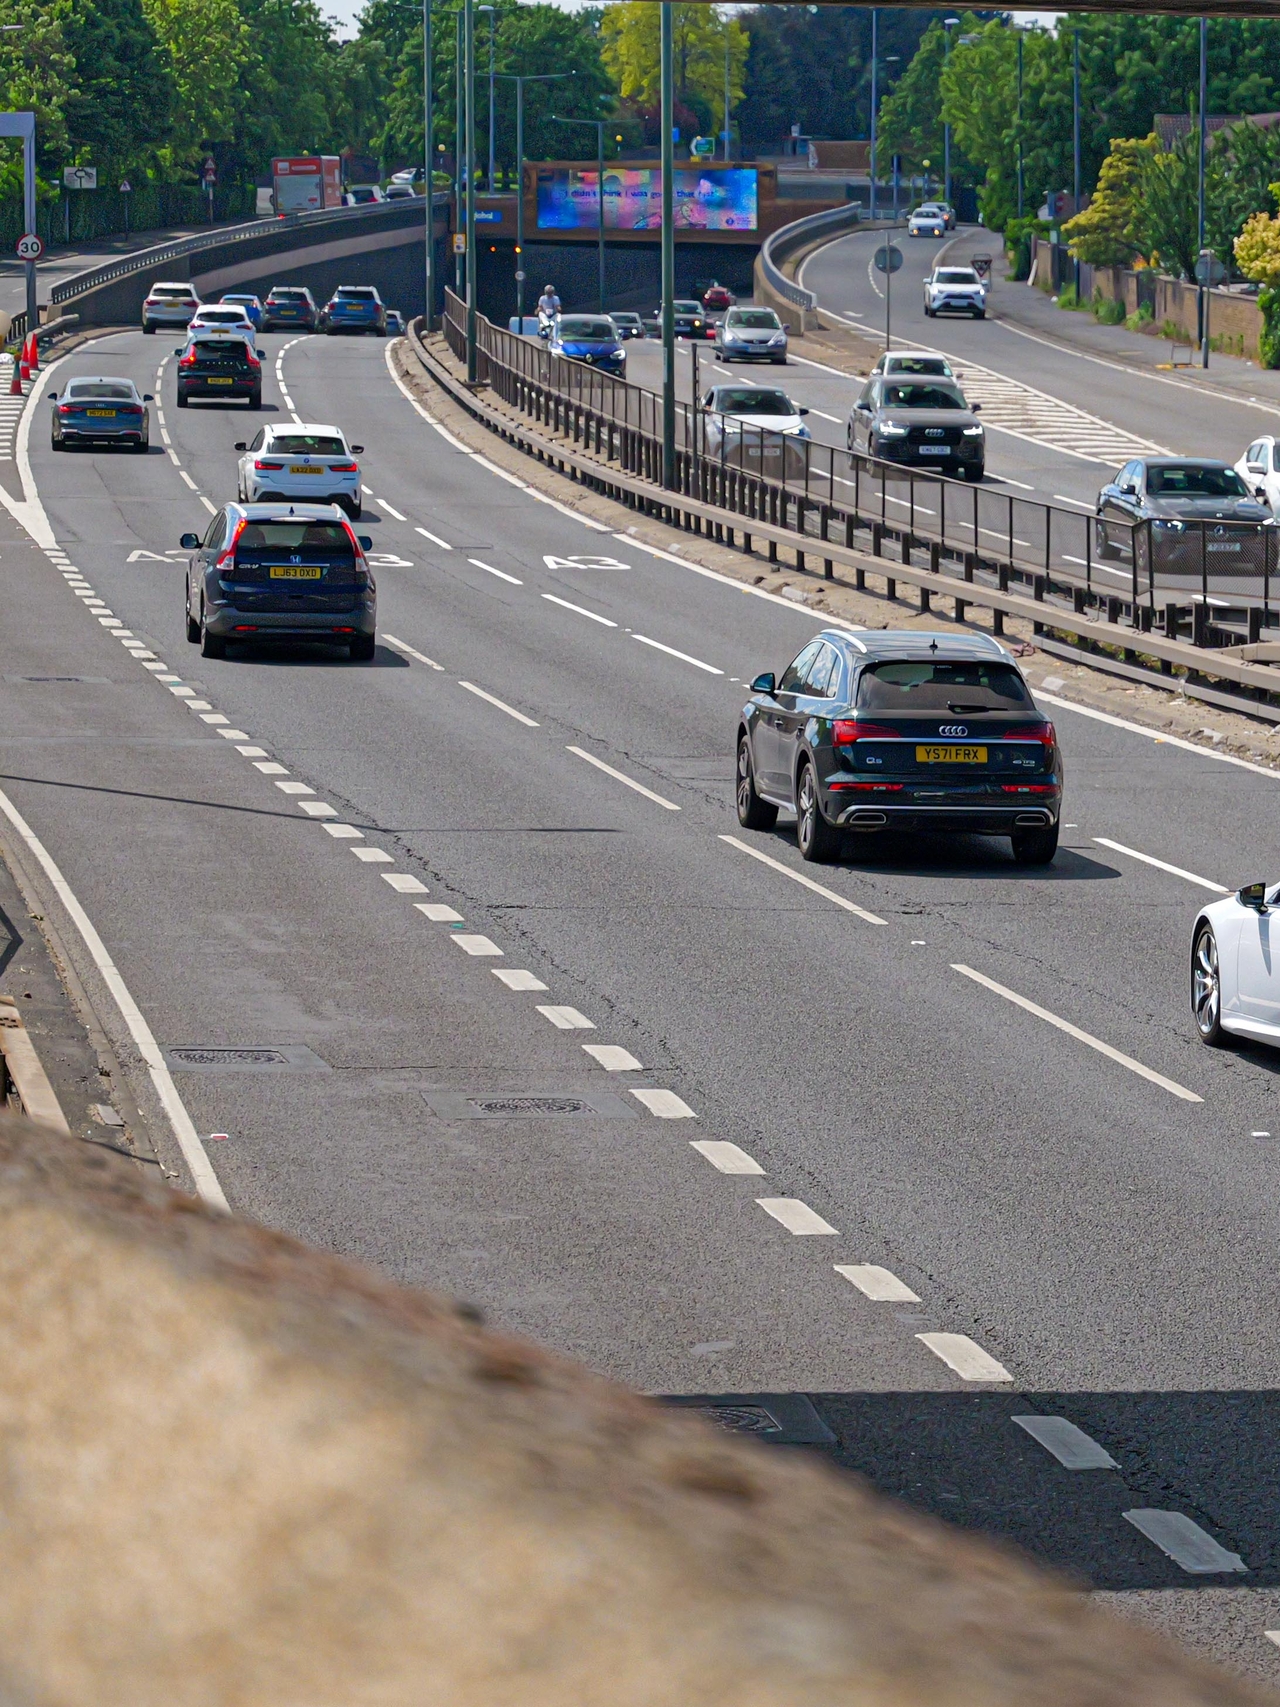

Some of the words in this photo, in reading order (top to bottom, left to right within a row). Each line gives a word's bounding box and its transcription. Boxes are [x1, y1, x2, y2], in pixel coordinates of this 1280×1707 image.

[603, 189, 621, 197] hink
[21, 242, 40, 253] 30
[542, 555, 631, 569] A3
[273, 568, 297, 577] LJ63
[924, 748, 952, 760] YS71
[955, 748, 979, 760] FRX
